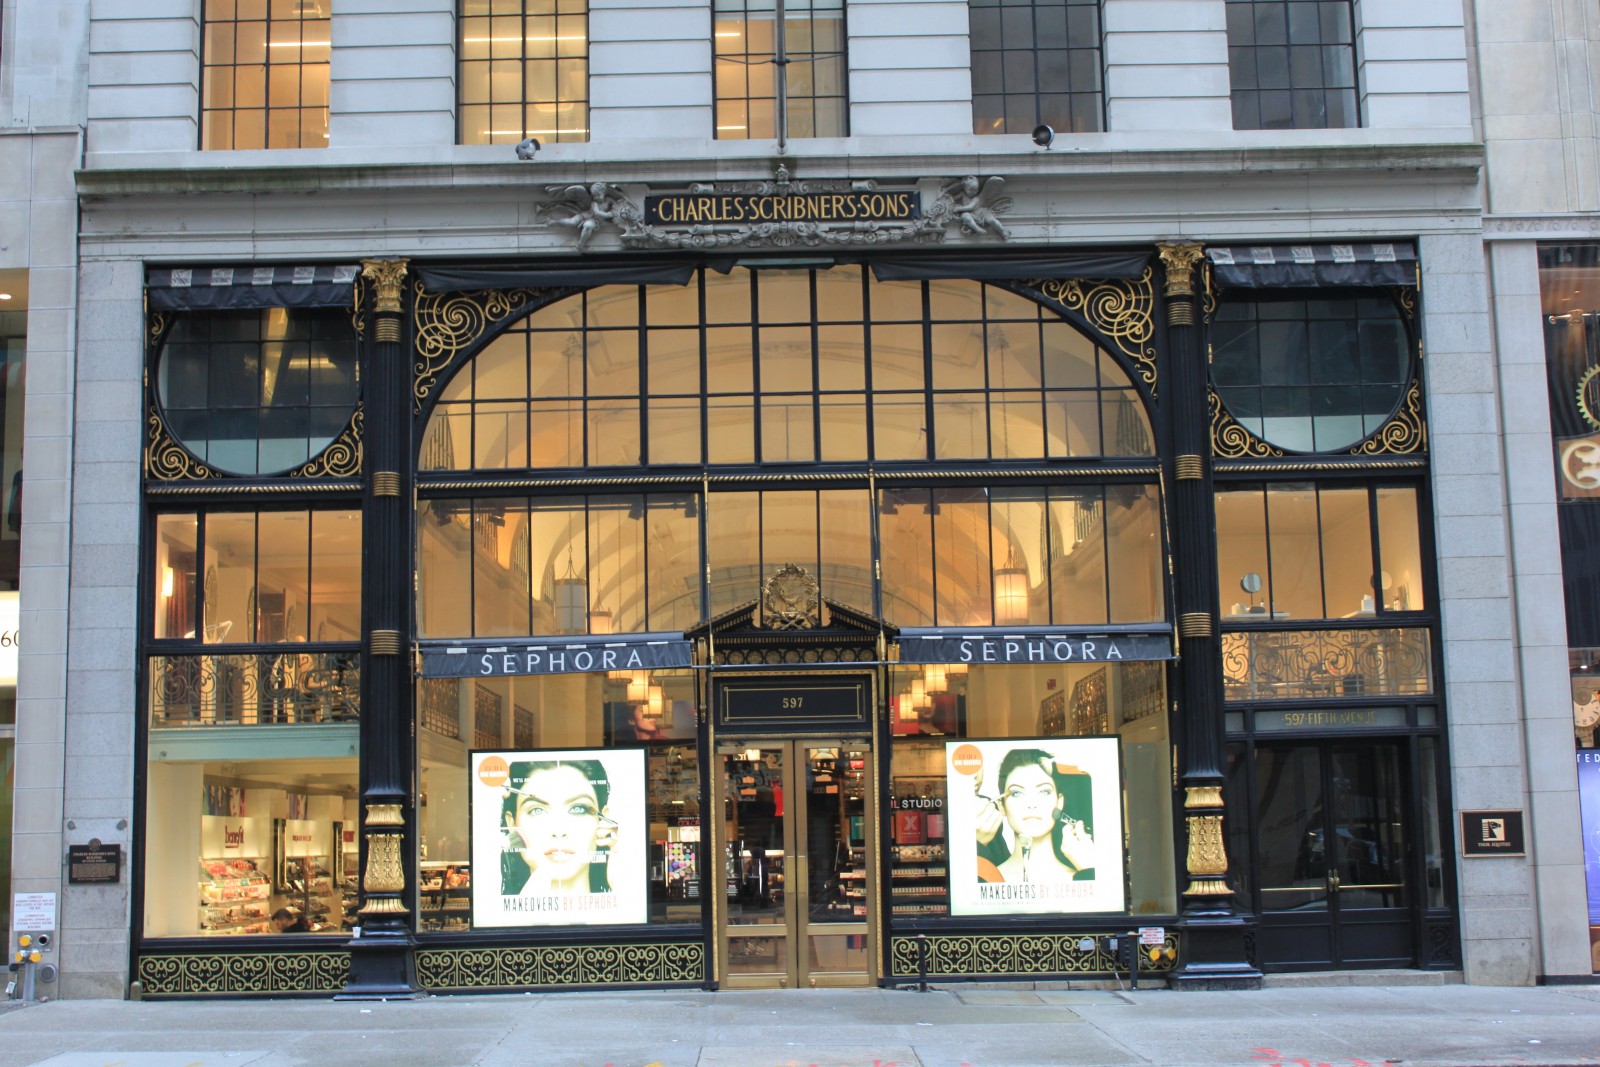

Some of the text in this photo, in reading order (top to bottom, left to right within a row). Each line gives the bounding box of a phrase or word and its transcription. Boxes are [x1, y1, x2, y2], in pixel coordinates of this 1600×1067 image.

[658, 197, 744, 221] CHARLES
[860, 194, 910, 218] SONS
[960, 640, 1123, 661] SEPHORA
[480, 649, 643, 674] SEPHORA
[782, 697, 804, 709] 597
[1308, 712, 1336, 725] FIFTH
[901, 799, 943, 808] STUDIO
[224, 825, 245, 848] benefit
[981, 883, 1094, 900] MAKEOVERS BY SEPHORA
[503, 895, 618, 912] MAKEOVERS BY SEPHORA
